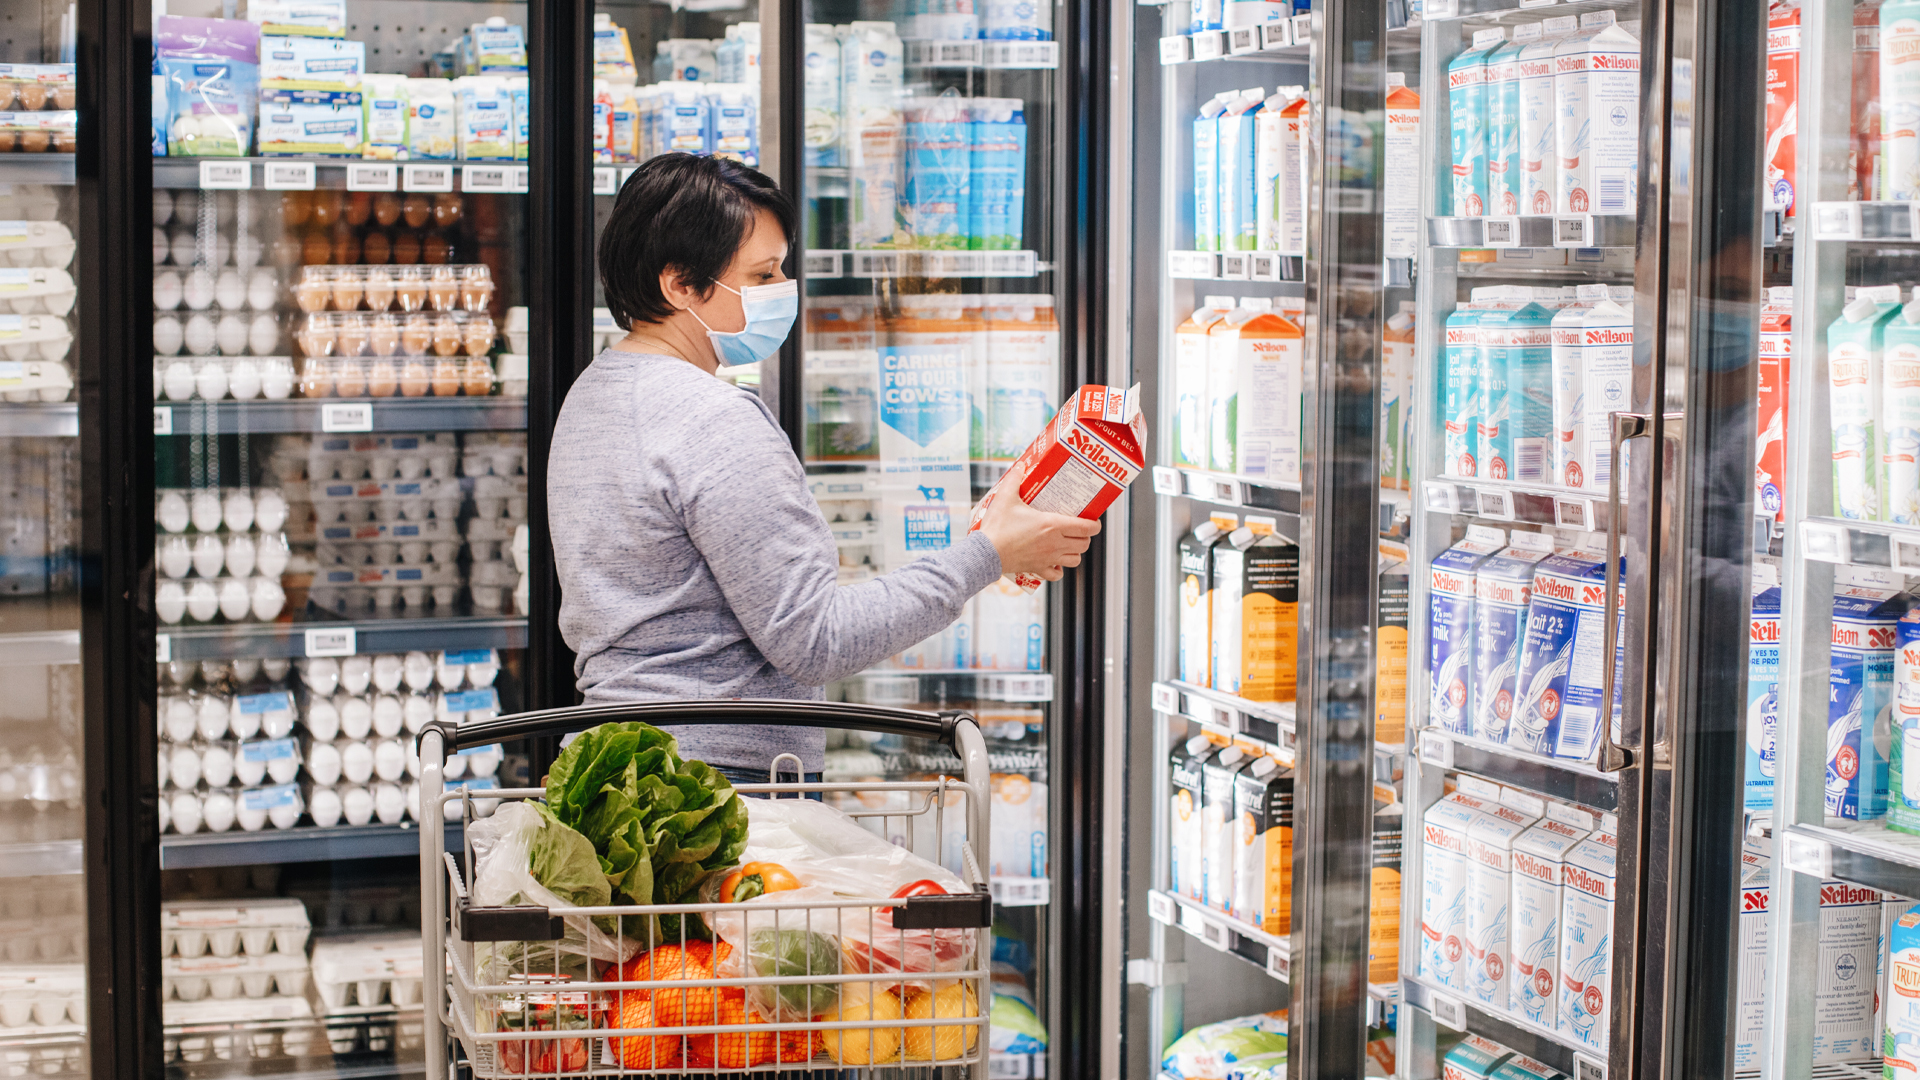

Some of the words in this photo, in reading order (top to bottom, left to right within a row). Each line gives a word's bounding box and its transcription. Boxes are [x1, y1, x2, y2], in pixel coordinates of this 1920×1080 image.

[1520, 61, 1550, 77] Neilson
[1556, 56, 1587, 73] Neilson
[1592, 54, 1640, 70] Neilson
[1450, 70, 1478, 87] Neilson
[1489, 66, 1514, 82] Neilson
[1453, 106, 1467, 118] skim
[1503, 113, 1516, 125] 0.1%
[1453, 118, 1466, 131] milk
[1570, 222, 1583, 231] 3.09
[1447, 330, 1476, 344] Neilson
[1552, 330, 1580, 345] Neilson
[1585, 329, 1633, 345] Neilson
[1252, 342, 1288, 353] Neilson
[884, 353, 957, 371] CARING
[1449, 353, 1460, 365] lait
[1449, 364, 1478, 376] écrémé
[1833, 362, 1867, 378] TRUTASTE
[885, 371, 918, 387] FOR
[921, 370, 957, 386] OUR
[1449, 377, 1460, 388] 0.1%
[1492, 379, 1507, 391] 0.1%
[886, 387, 958, 404] COWS.
[1094, 420, 1118, 438] SPOUT
[1120, 437, 1136, 453] BEC
[1067, 428, 1129, 483] Neilson
[934, 464, 964, 472] STANDARDS.
[907, 510, 945, 521] DAIRY
[908, 521, 946, 532] FARMERS
[1432, 572, 1465, 593] Neilson
[1533, 575, 1575, 601] Neilson
[1477, 581, 1514, 602] Neilson
[1850, 603, 1873, 612] milk
[1529, 612, 1547, 631] lait
[1433, 625, 1450, 642] milk
[1478, 635, 1497, 652] milk
[1867, 664, 1888, 672] MORE
[1897, 681, 1910, 699] 2%
[1451, 795, 1483, 809] Neilson
[1844, 804, 1851, 814] 2
[1851, 806, 1856, 816] L
[1454, 812, 1472, 822] milk
[1542, 821, 1577, 837] Neilson
[1425, 825, 1463, 852] Neilson
[1545, 840, 1565, 851] milk
[1467, 840, 1503, 868] Neilson
[1514, 852, 1553, 881] Neilson
[1426, 879, 1443, 896] milk
[1566, 866, 1607, 897] Neilson
[1820, 884, 1875, 906] Neilson
[1566, 925, 1585, 945] milk
[1590, 1068, 1602, 1079] 6.09
